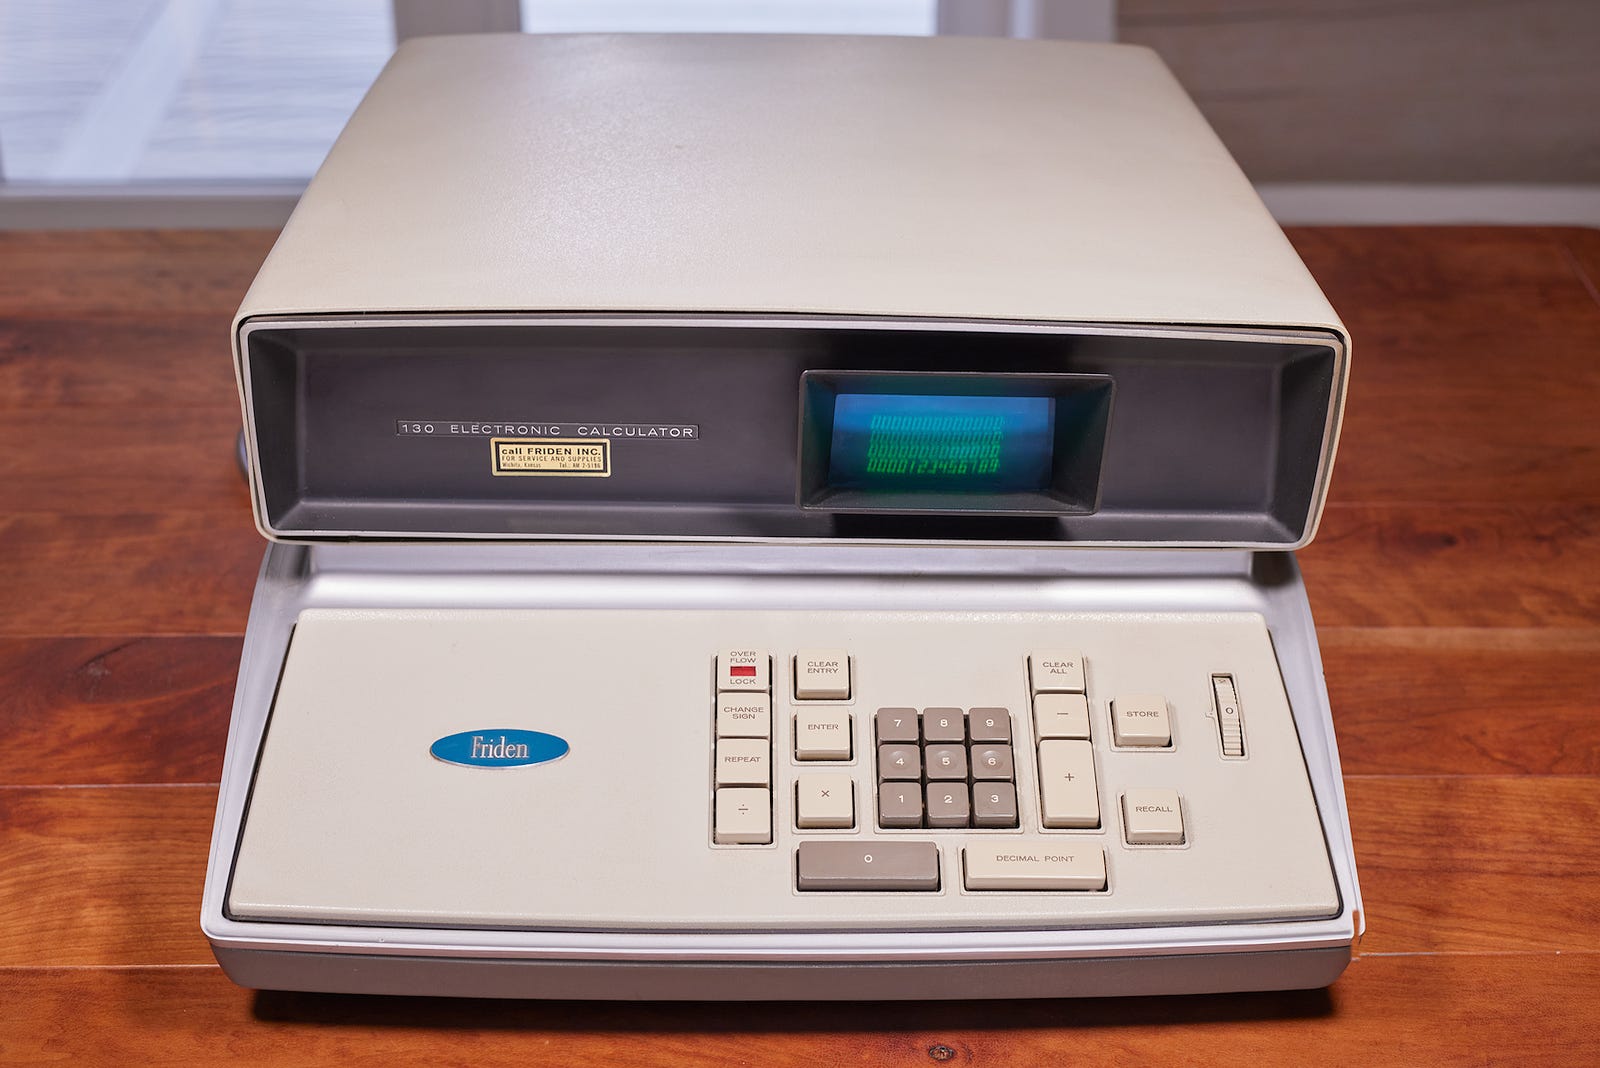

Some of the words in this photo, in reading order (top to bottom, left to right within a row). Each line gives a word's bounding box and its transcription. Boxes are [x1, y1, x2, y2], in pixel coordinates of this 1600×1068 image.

[401, 423, 435, 434] 130
[450, 424, 561, 436] ELECTRONIC
[577, 426, 694, 438] CALCULATOR
[501, 447, 522, 455] call
[527, 447, 572, 455] FRIDEN
[577, 448, 601, 456] INC.
[867, 458, 1000, 474] 0000123456789
[1126, 710, 1160, 718] STORE
[807, 723, 839, 731] ENTER
[893, 719, 902, 728] 7
[940, 719, 948, 728] 8
[985, 719, 994, 728] 9
[471, 735, 529, 759] Friden
[895, 757, 905, 766] 4
[941, 757, 950, 766] 5
[987, 757, 996, 766] 6
[898, 795, 905, 804] 1
[943, 794, 953, 804] 2
[990, 794, 999, 803] 3
[1135, 805, 1173, 813] RECALL
[996, 855, 1040, 863] DECIMAL
[1044, 855, 1075, 863] POINT
